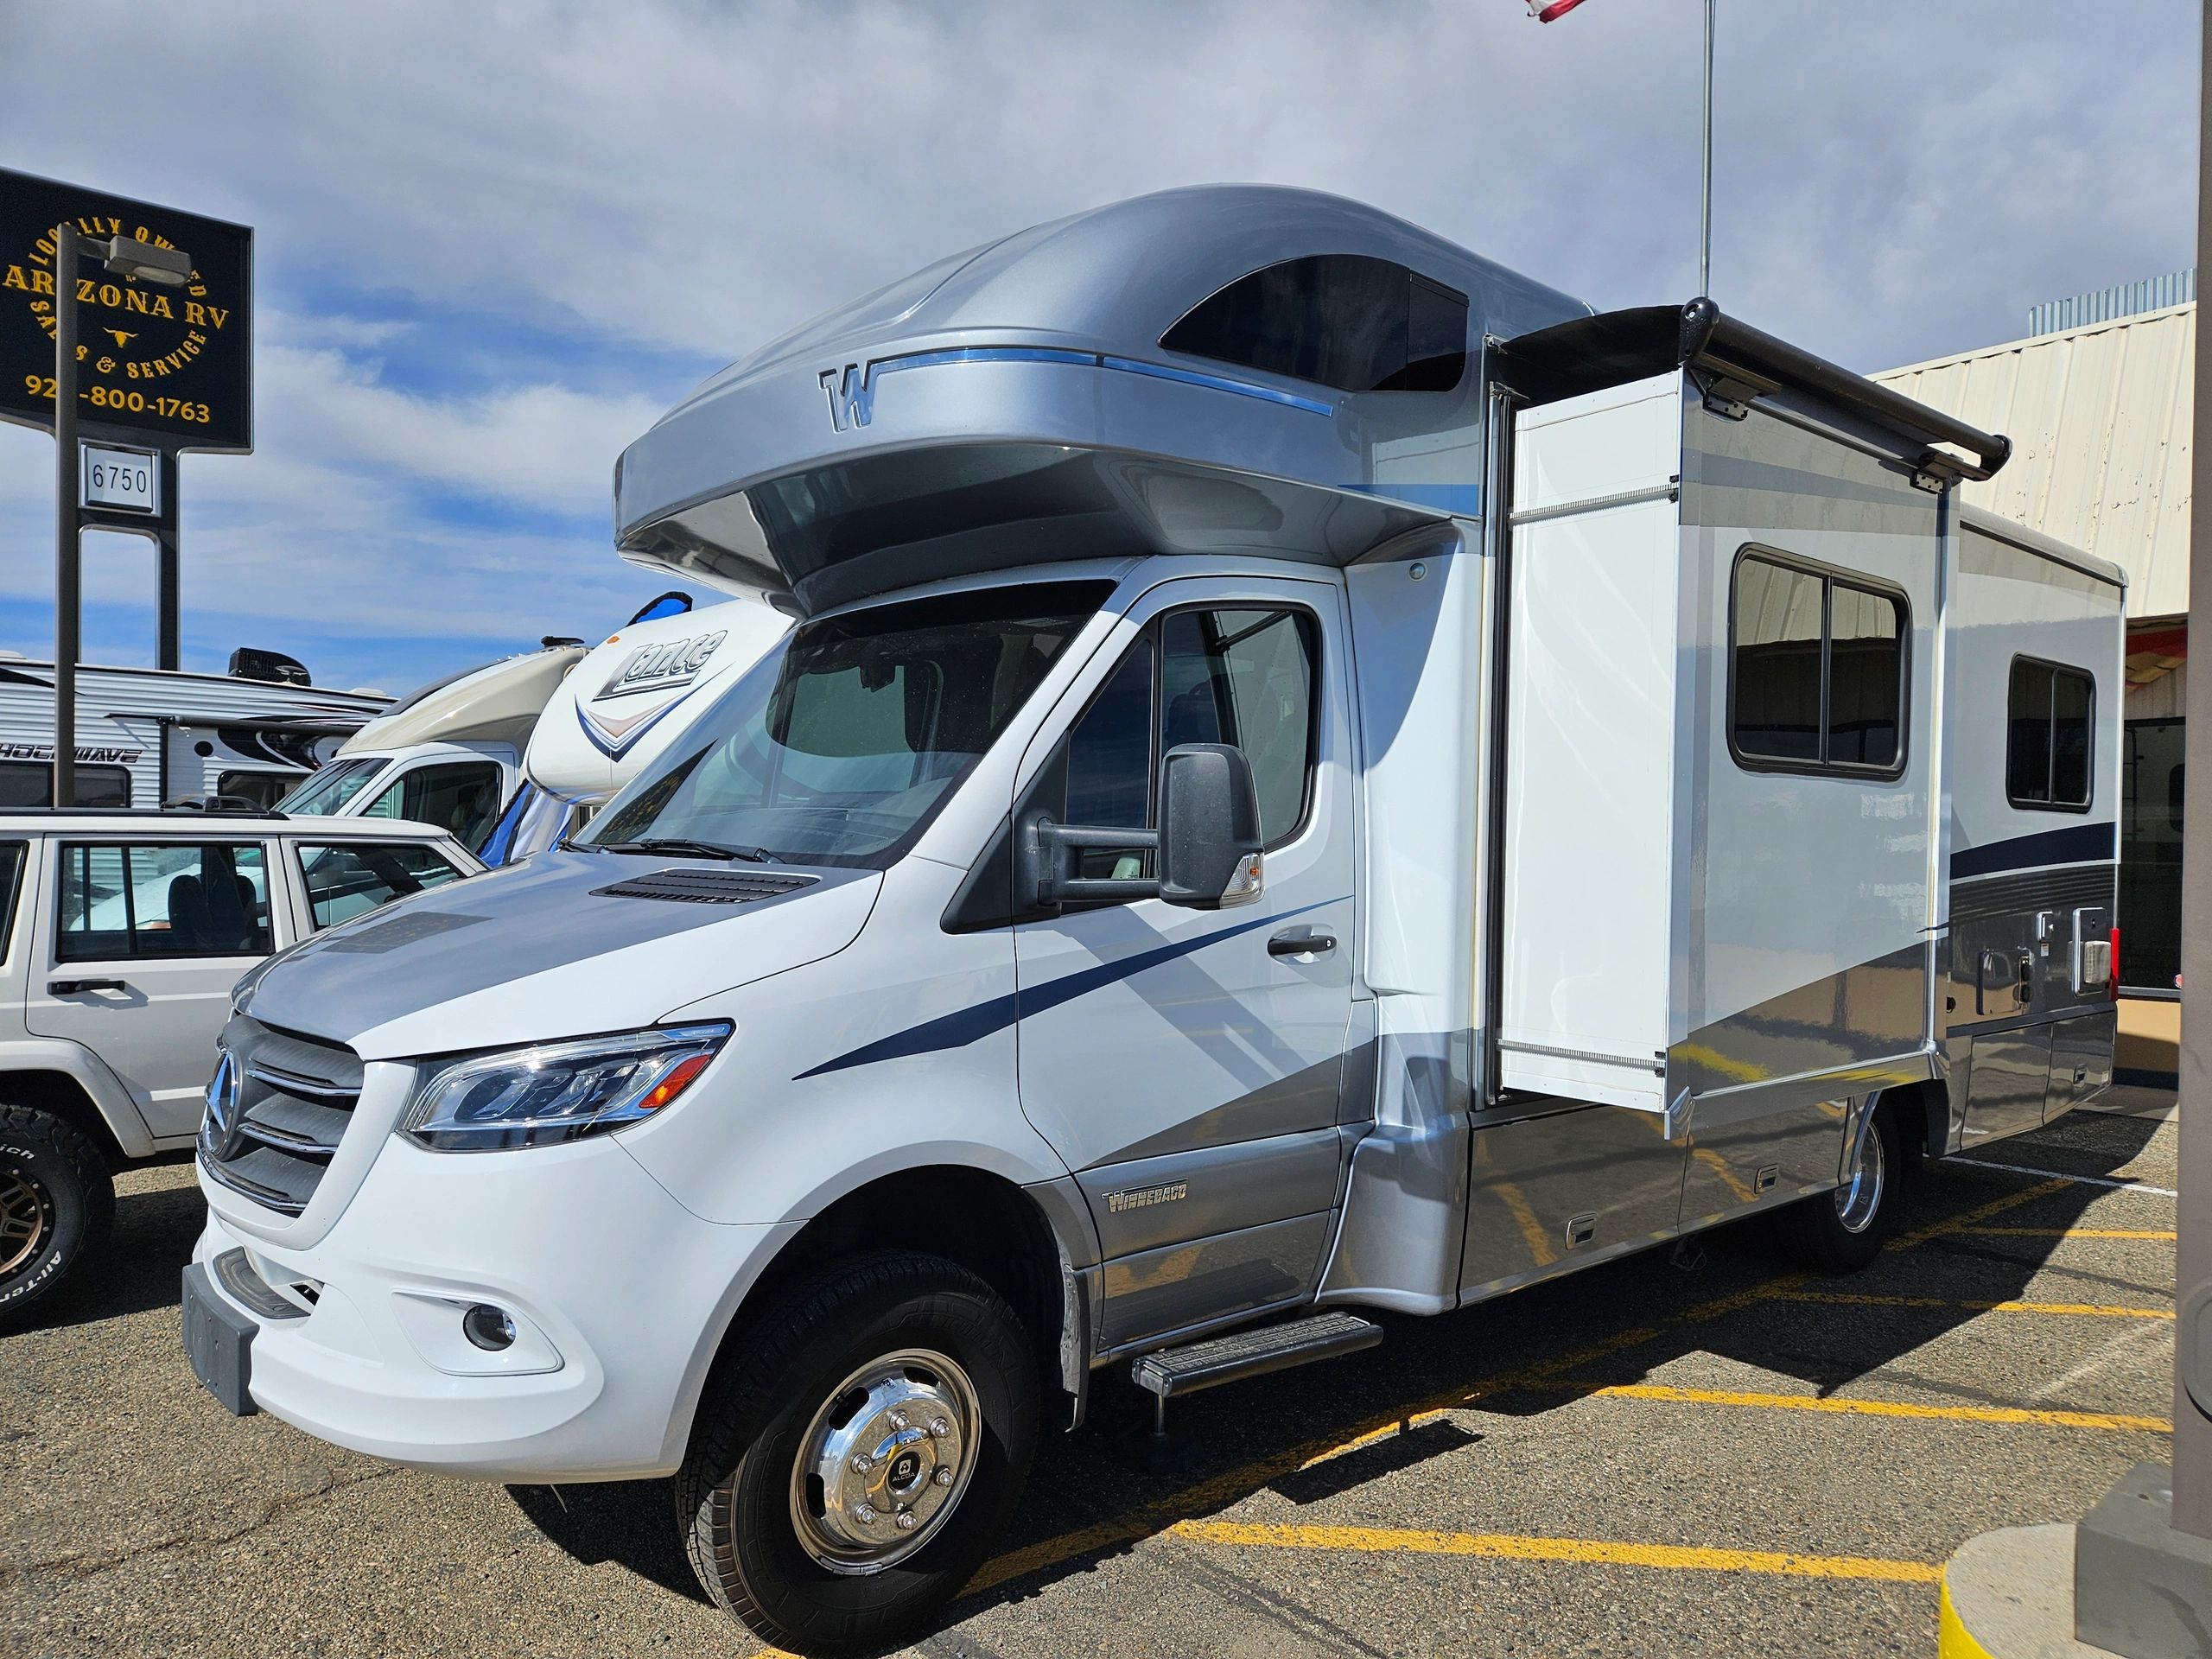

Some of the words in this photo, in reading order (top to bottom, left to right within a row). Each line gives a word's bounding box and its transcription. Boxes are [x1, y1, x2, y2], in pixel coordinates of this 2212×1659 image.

[29, 217, 121, 266] LOCLLY
[135, 226, 207, 296] OWED
[2, 264, 175, 320] ARZONA
[184, 301, 229, 330] RV
[30, 300, 88, 361] SAS
[96, 356, 116, 373] &
[126, 329, 207, 378] SERVICE
[25, 375, 210, 423] 92-800-1763
[92, 464, 147, 493] 6750
[591, 629, 728, 702] Lance
[892, 1471, 915, 1483] ALCOA
